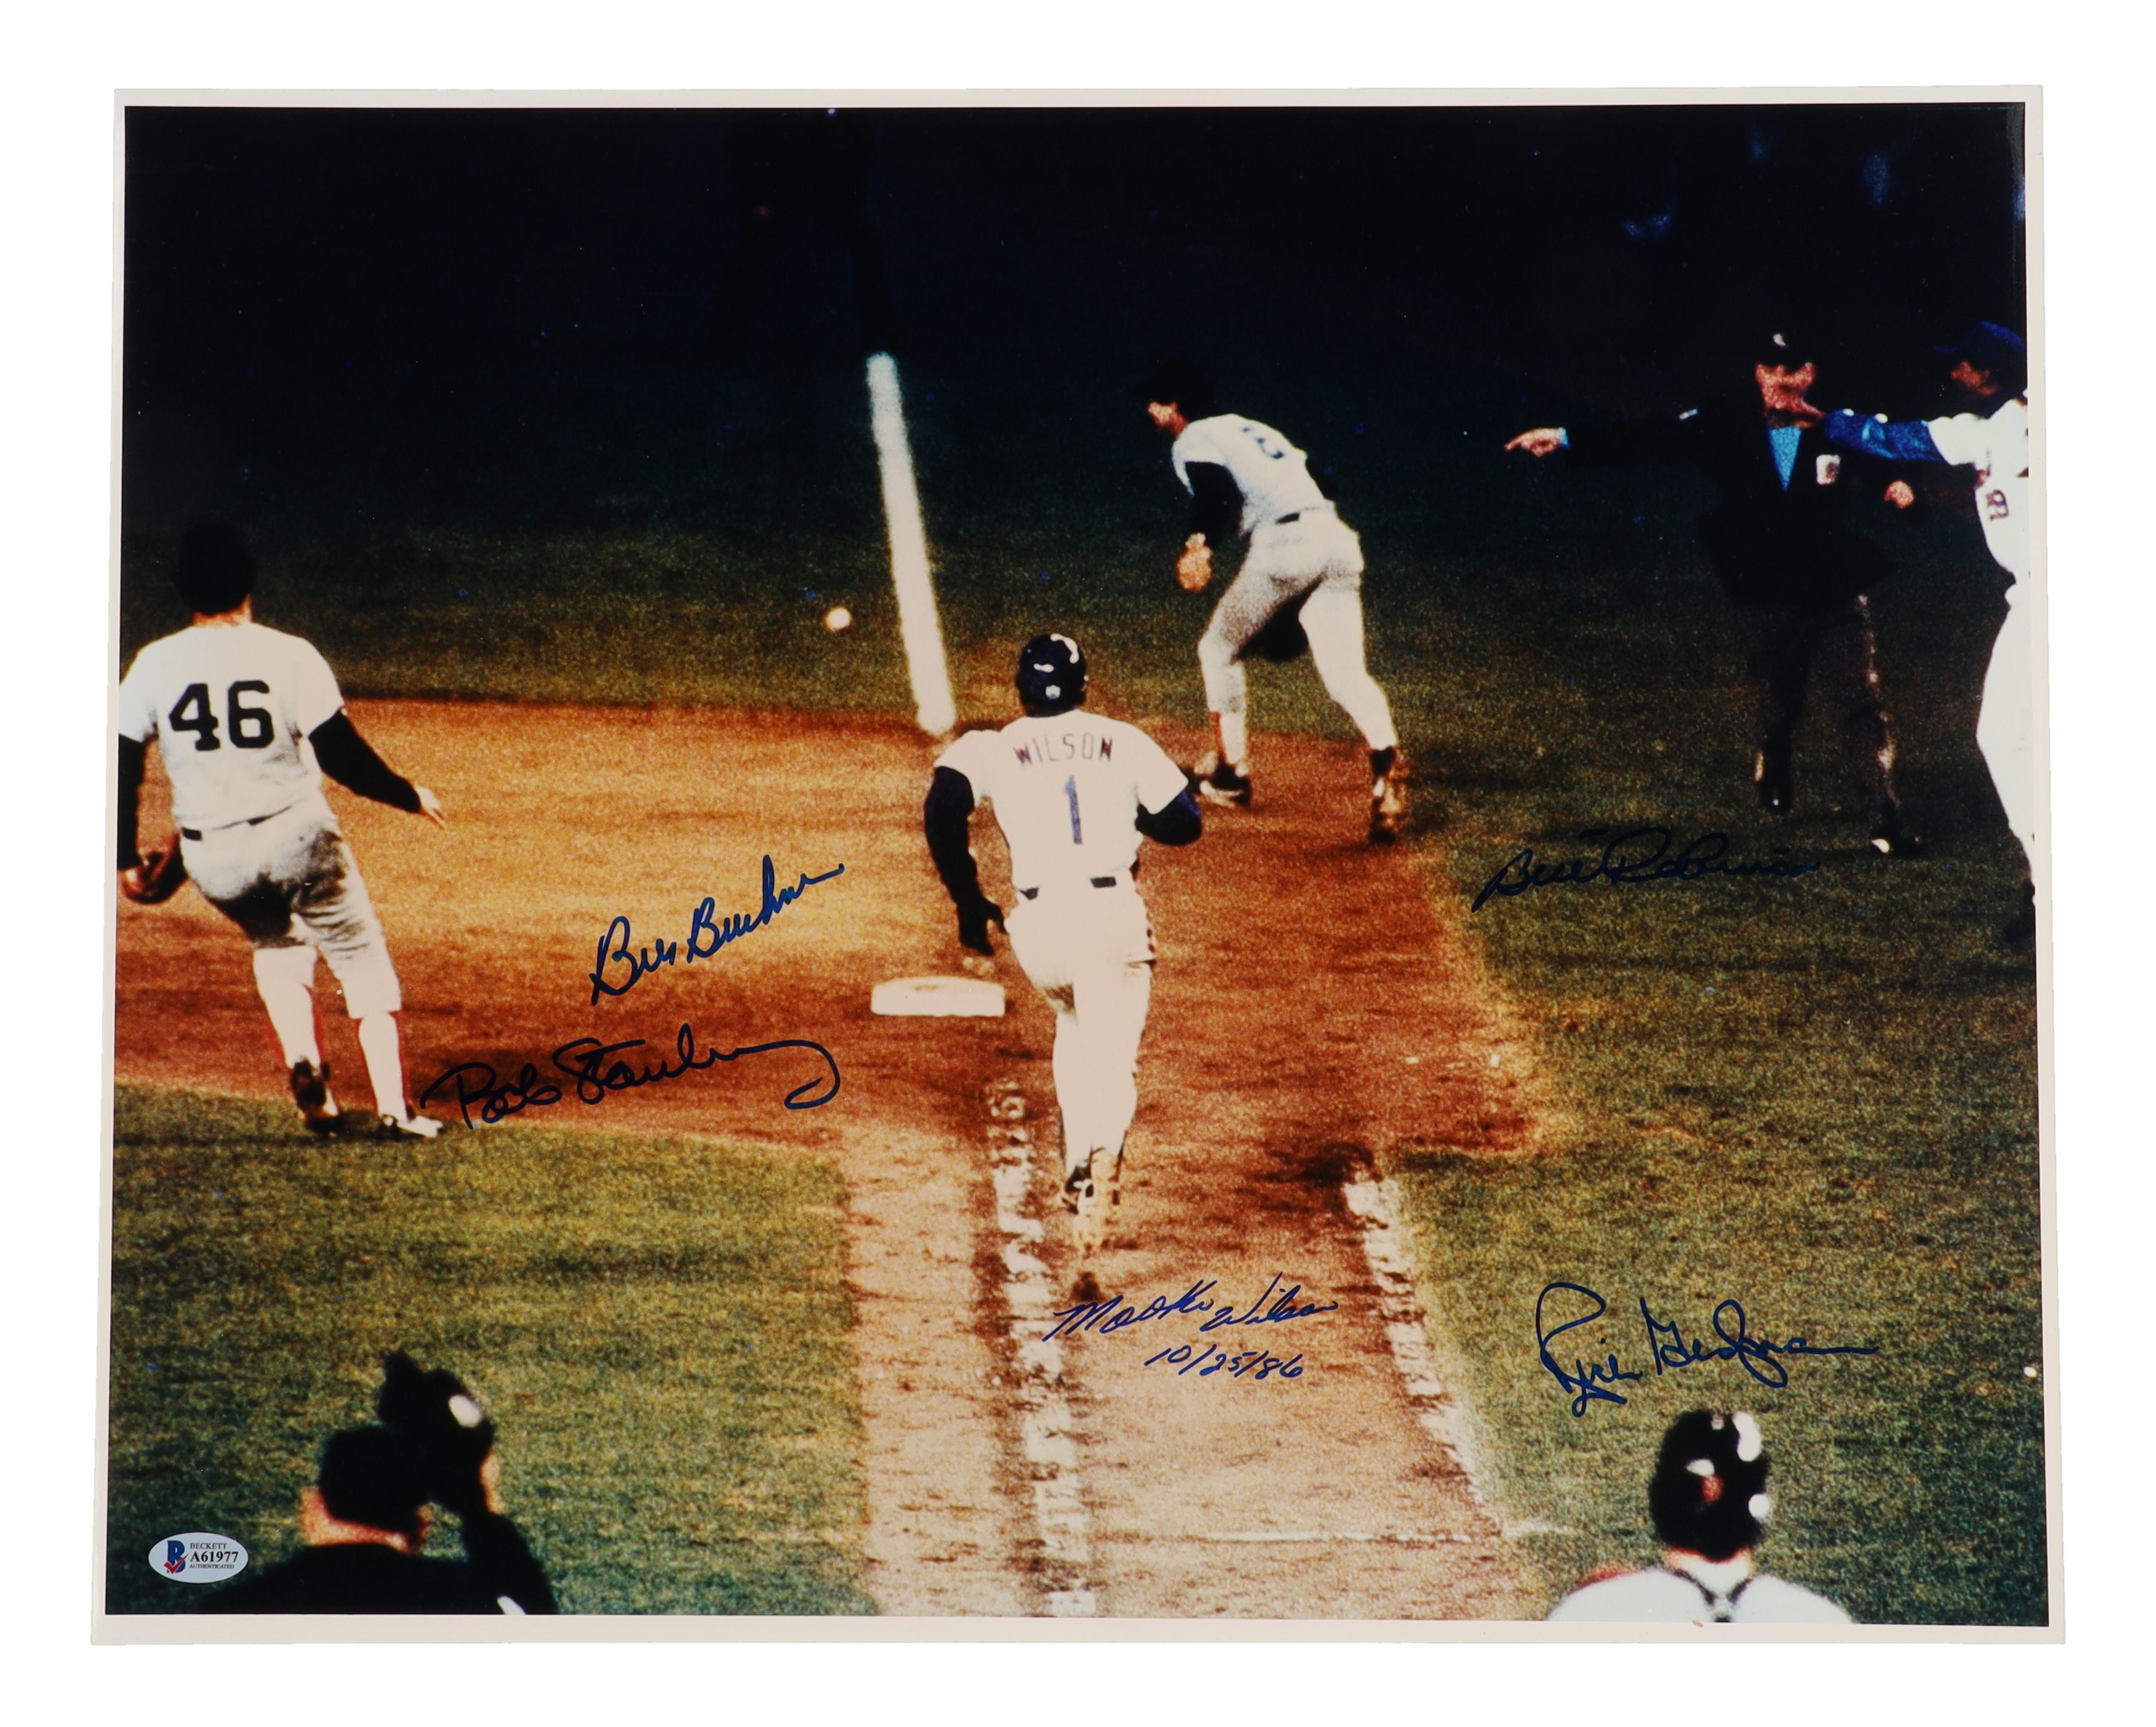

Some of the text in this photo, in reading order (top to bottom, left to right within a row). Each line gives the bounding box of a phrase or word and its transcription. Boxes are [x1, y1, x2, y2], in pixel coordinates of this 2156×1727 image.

[169, 680, 274, 751] 46
[1013, 732, 1113, 766] WILSON
[1063, 774, 1083, 845] 1
[1144, 1344, 1303, 1379] 10/25/86
[189, 1551, 238, 1563] A61977
